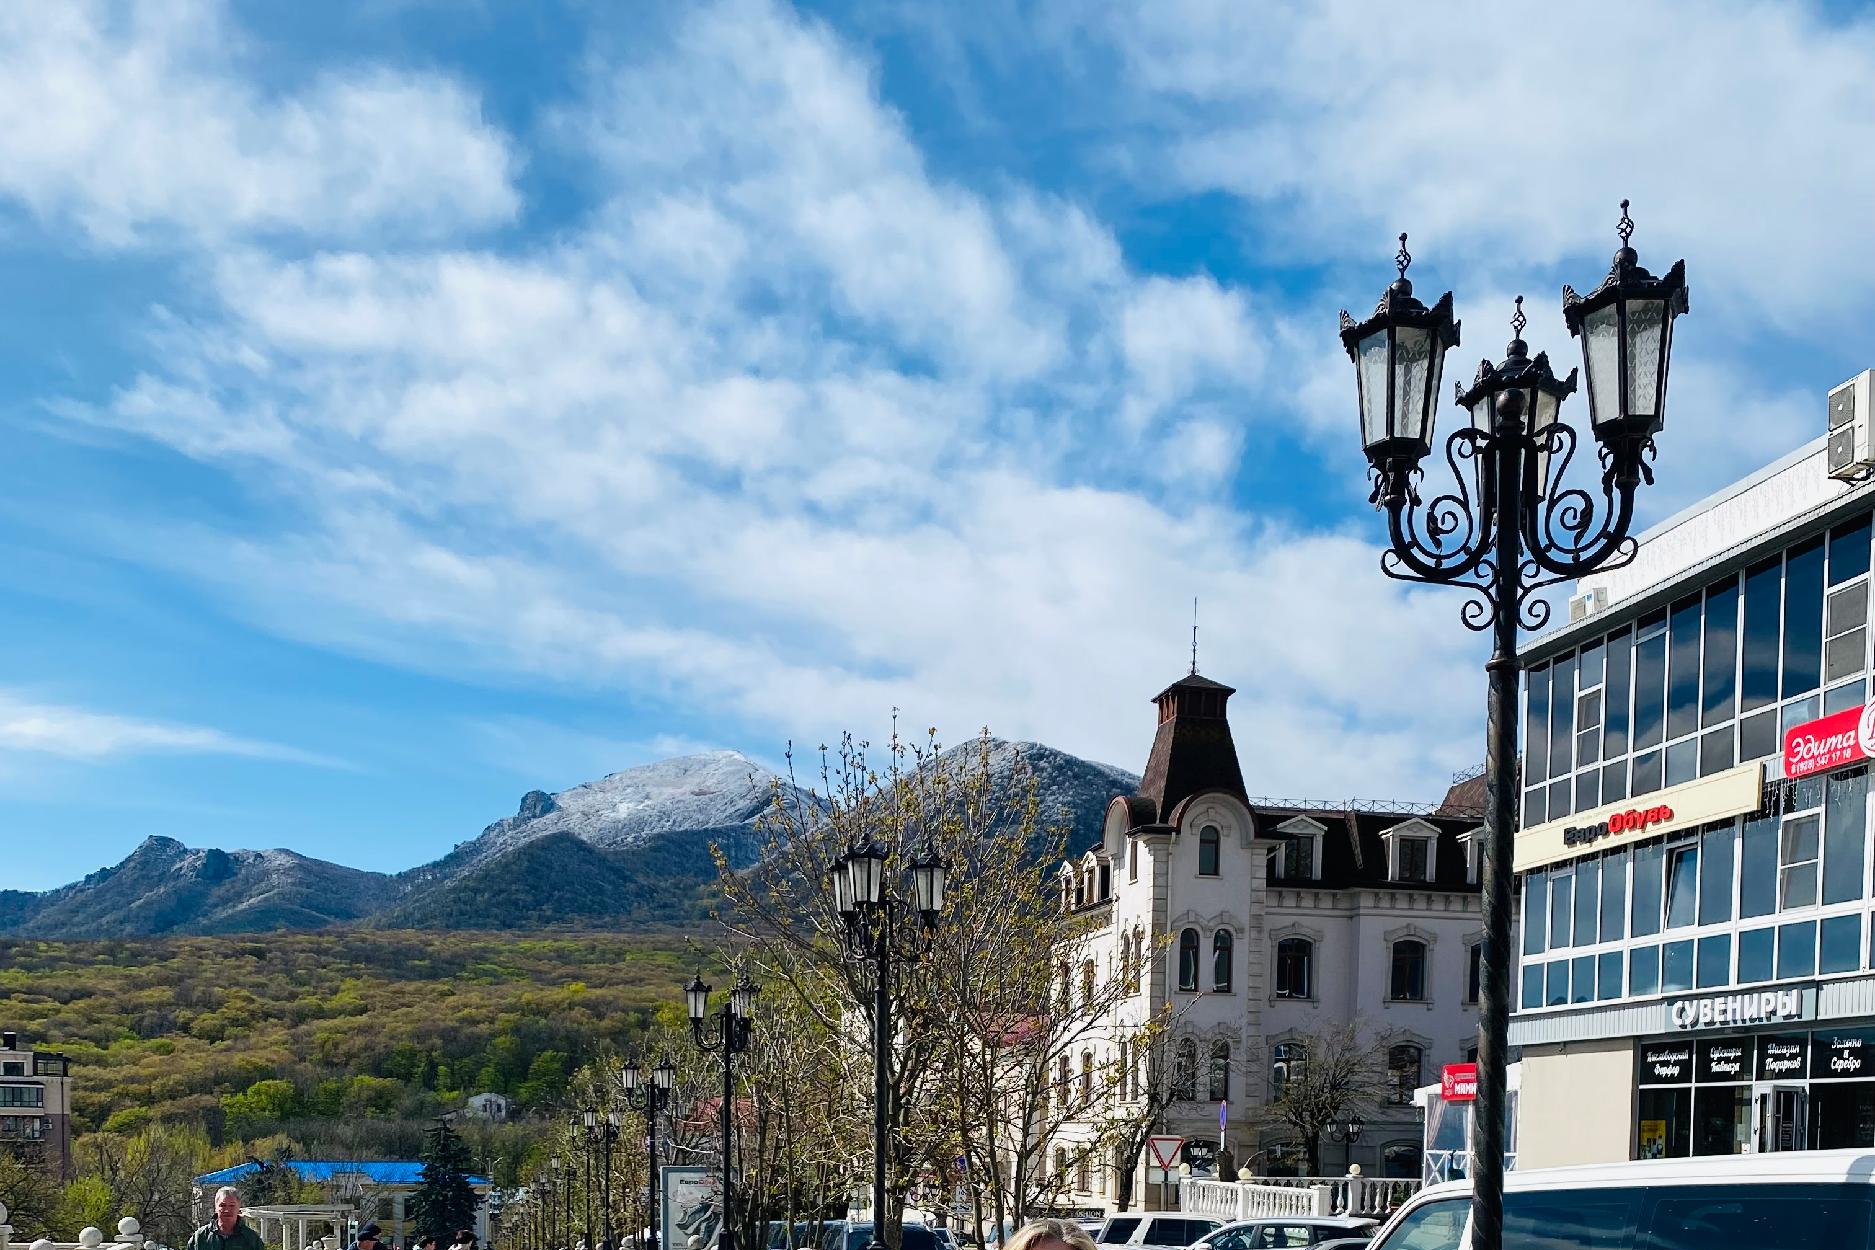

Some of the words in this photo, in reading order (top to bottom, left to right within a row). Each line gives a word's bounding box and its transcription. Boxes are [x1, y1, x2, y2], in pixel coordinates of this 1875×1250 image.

[1789, 730, 1856, 763] Эдита
[1831, 750, 1841, 762] 17
[1564, 805, 1672, 844] ЕвроОбувь
[1671, 989, 1799, 1027] СУВЕНИРЫ
[1710, 1047, 1742, 1060] Сувениры
[1767, 1043, 1800, 1057] Магазин
[1654, 1063, 1680, 1078] Фарфор
[1765, 1057, 1802, 1073] Подарков
[1831, 1057, 1862, 1073] Серебро
[1455, 1082, 1477, 1095] МИМИ
